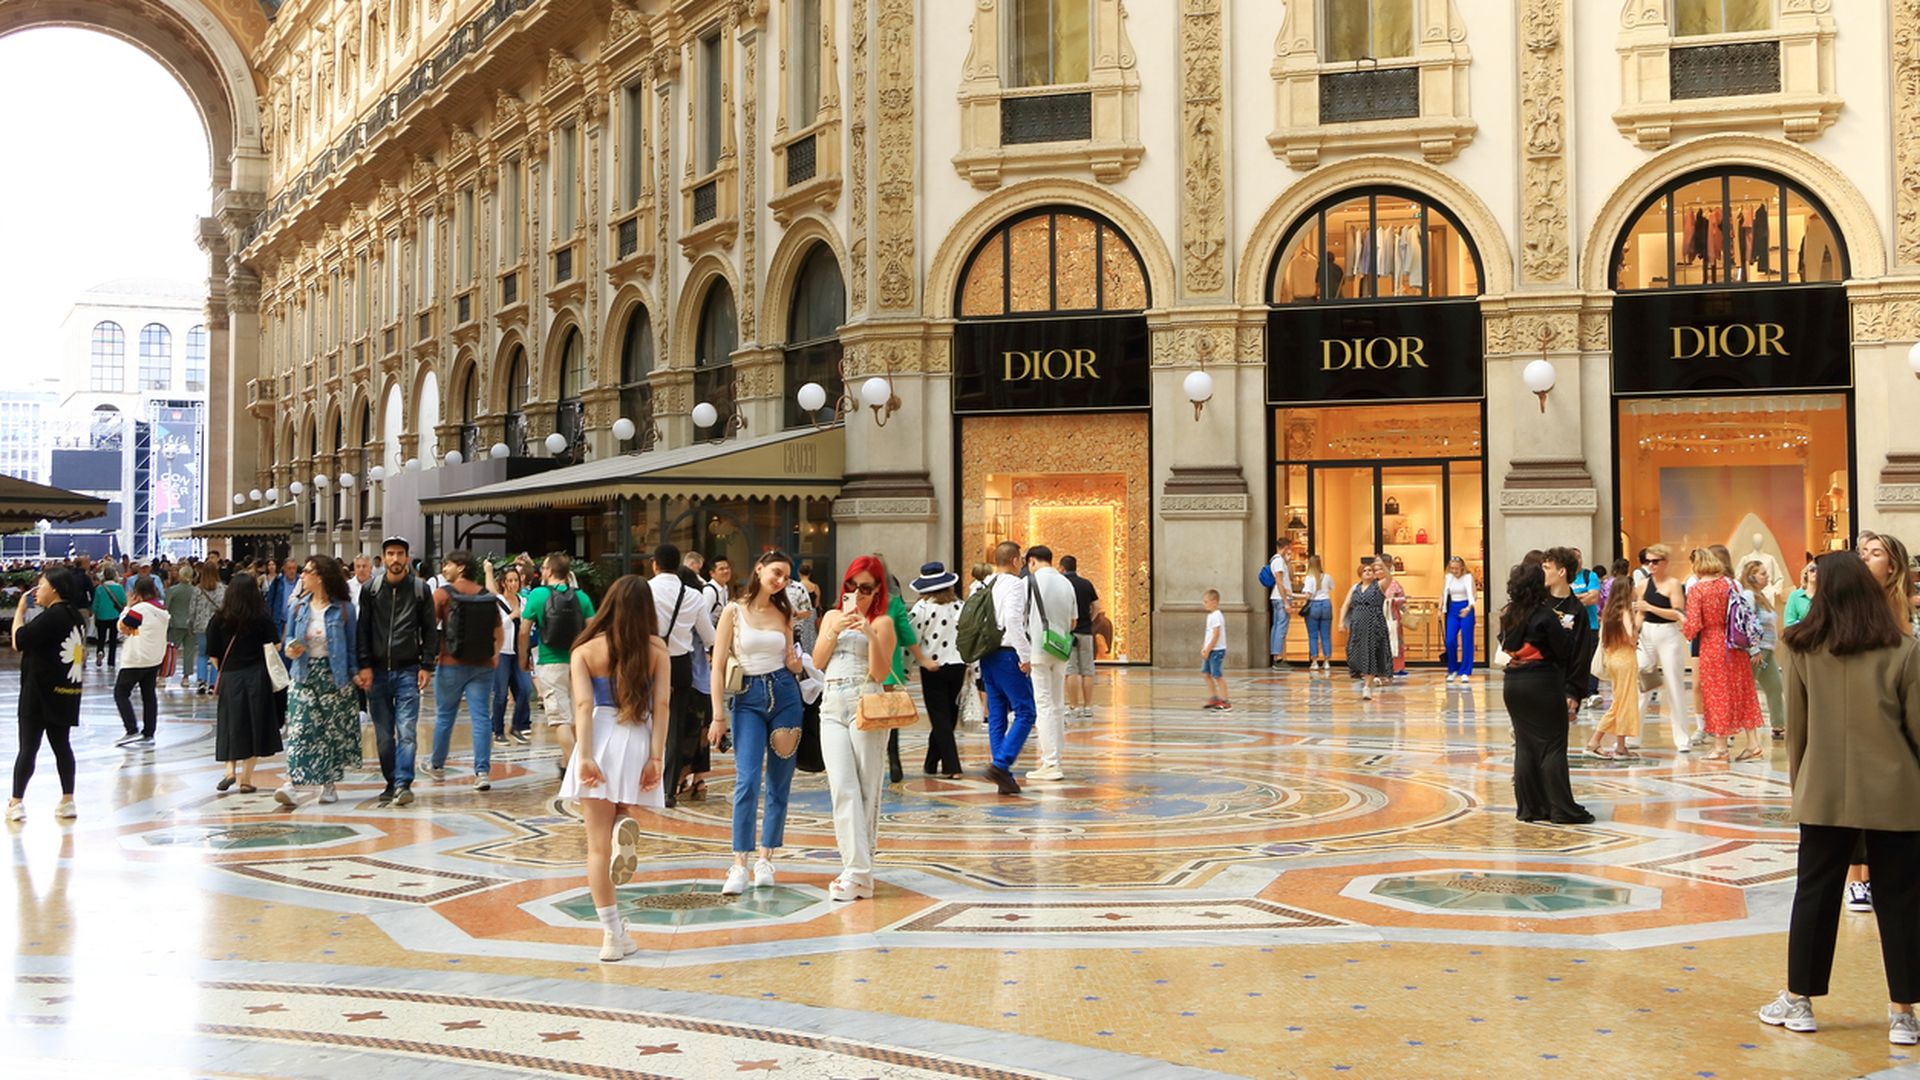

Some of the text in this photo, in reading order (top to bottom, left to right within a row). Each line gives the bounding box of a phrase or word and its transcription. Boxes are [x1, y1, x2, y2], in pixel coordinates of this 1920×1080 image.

[1321, 337, 1427, 369] DIOR
[1671, 324, 1788, 358] DIOR
[1003, 349, 1100, 381] DIOR
[161, 473, 190, 485] CON
